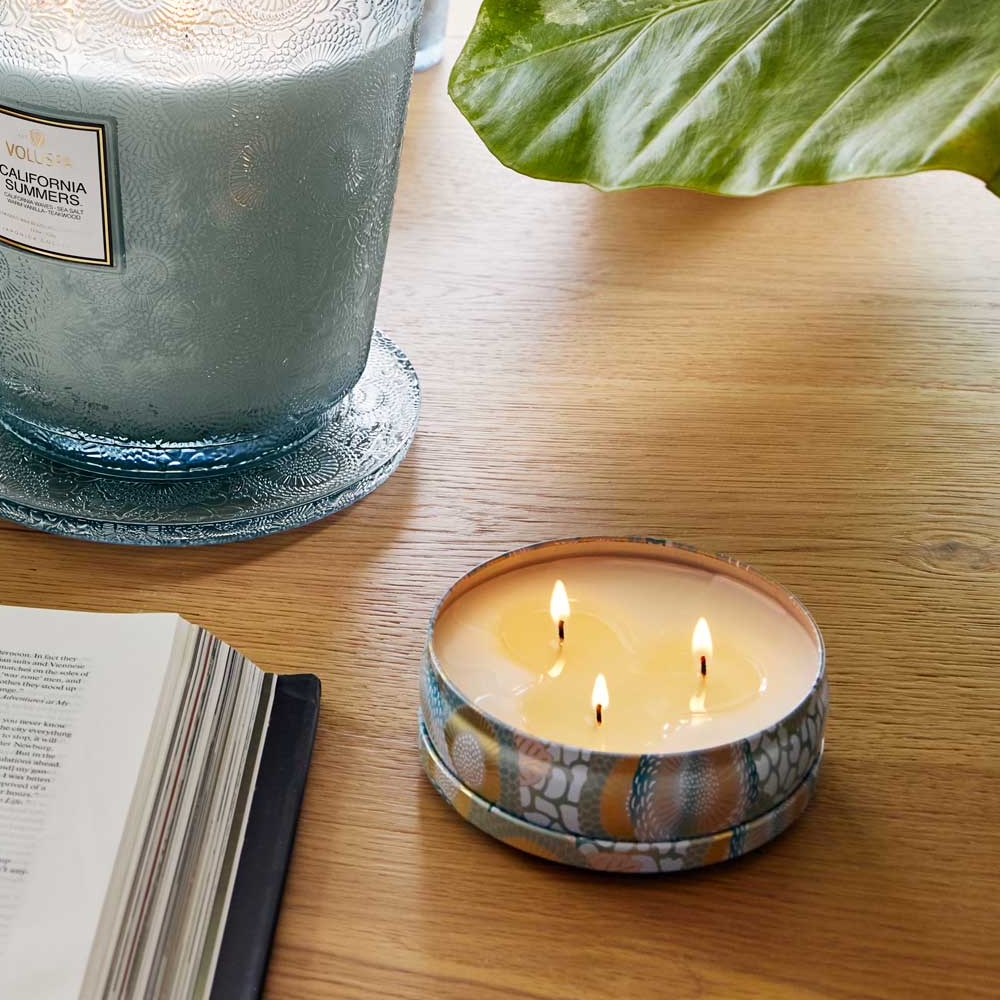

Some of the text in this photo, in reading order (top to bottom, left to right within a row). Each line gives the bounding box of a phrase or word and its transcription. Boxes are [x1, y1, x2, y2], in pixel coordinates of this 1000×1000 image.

[4, 178, 80, 206] SUMMERS
[4, 192, 34, 204] CALIFORNIA
[48, 210, 82, 220] TEAKWOOD
